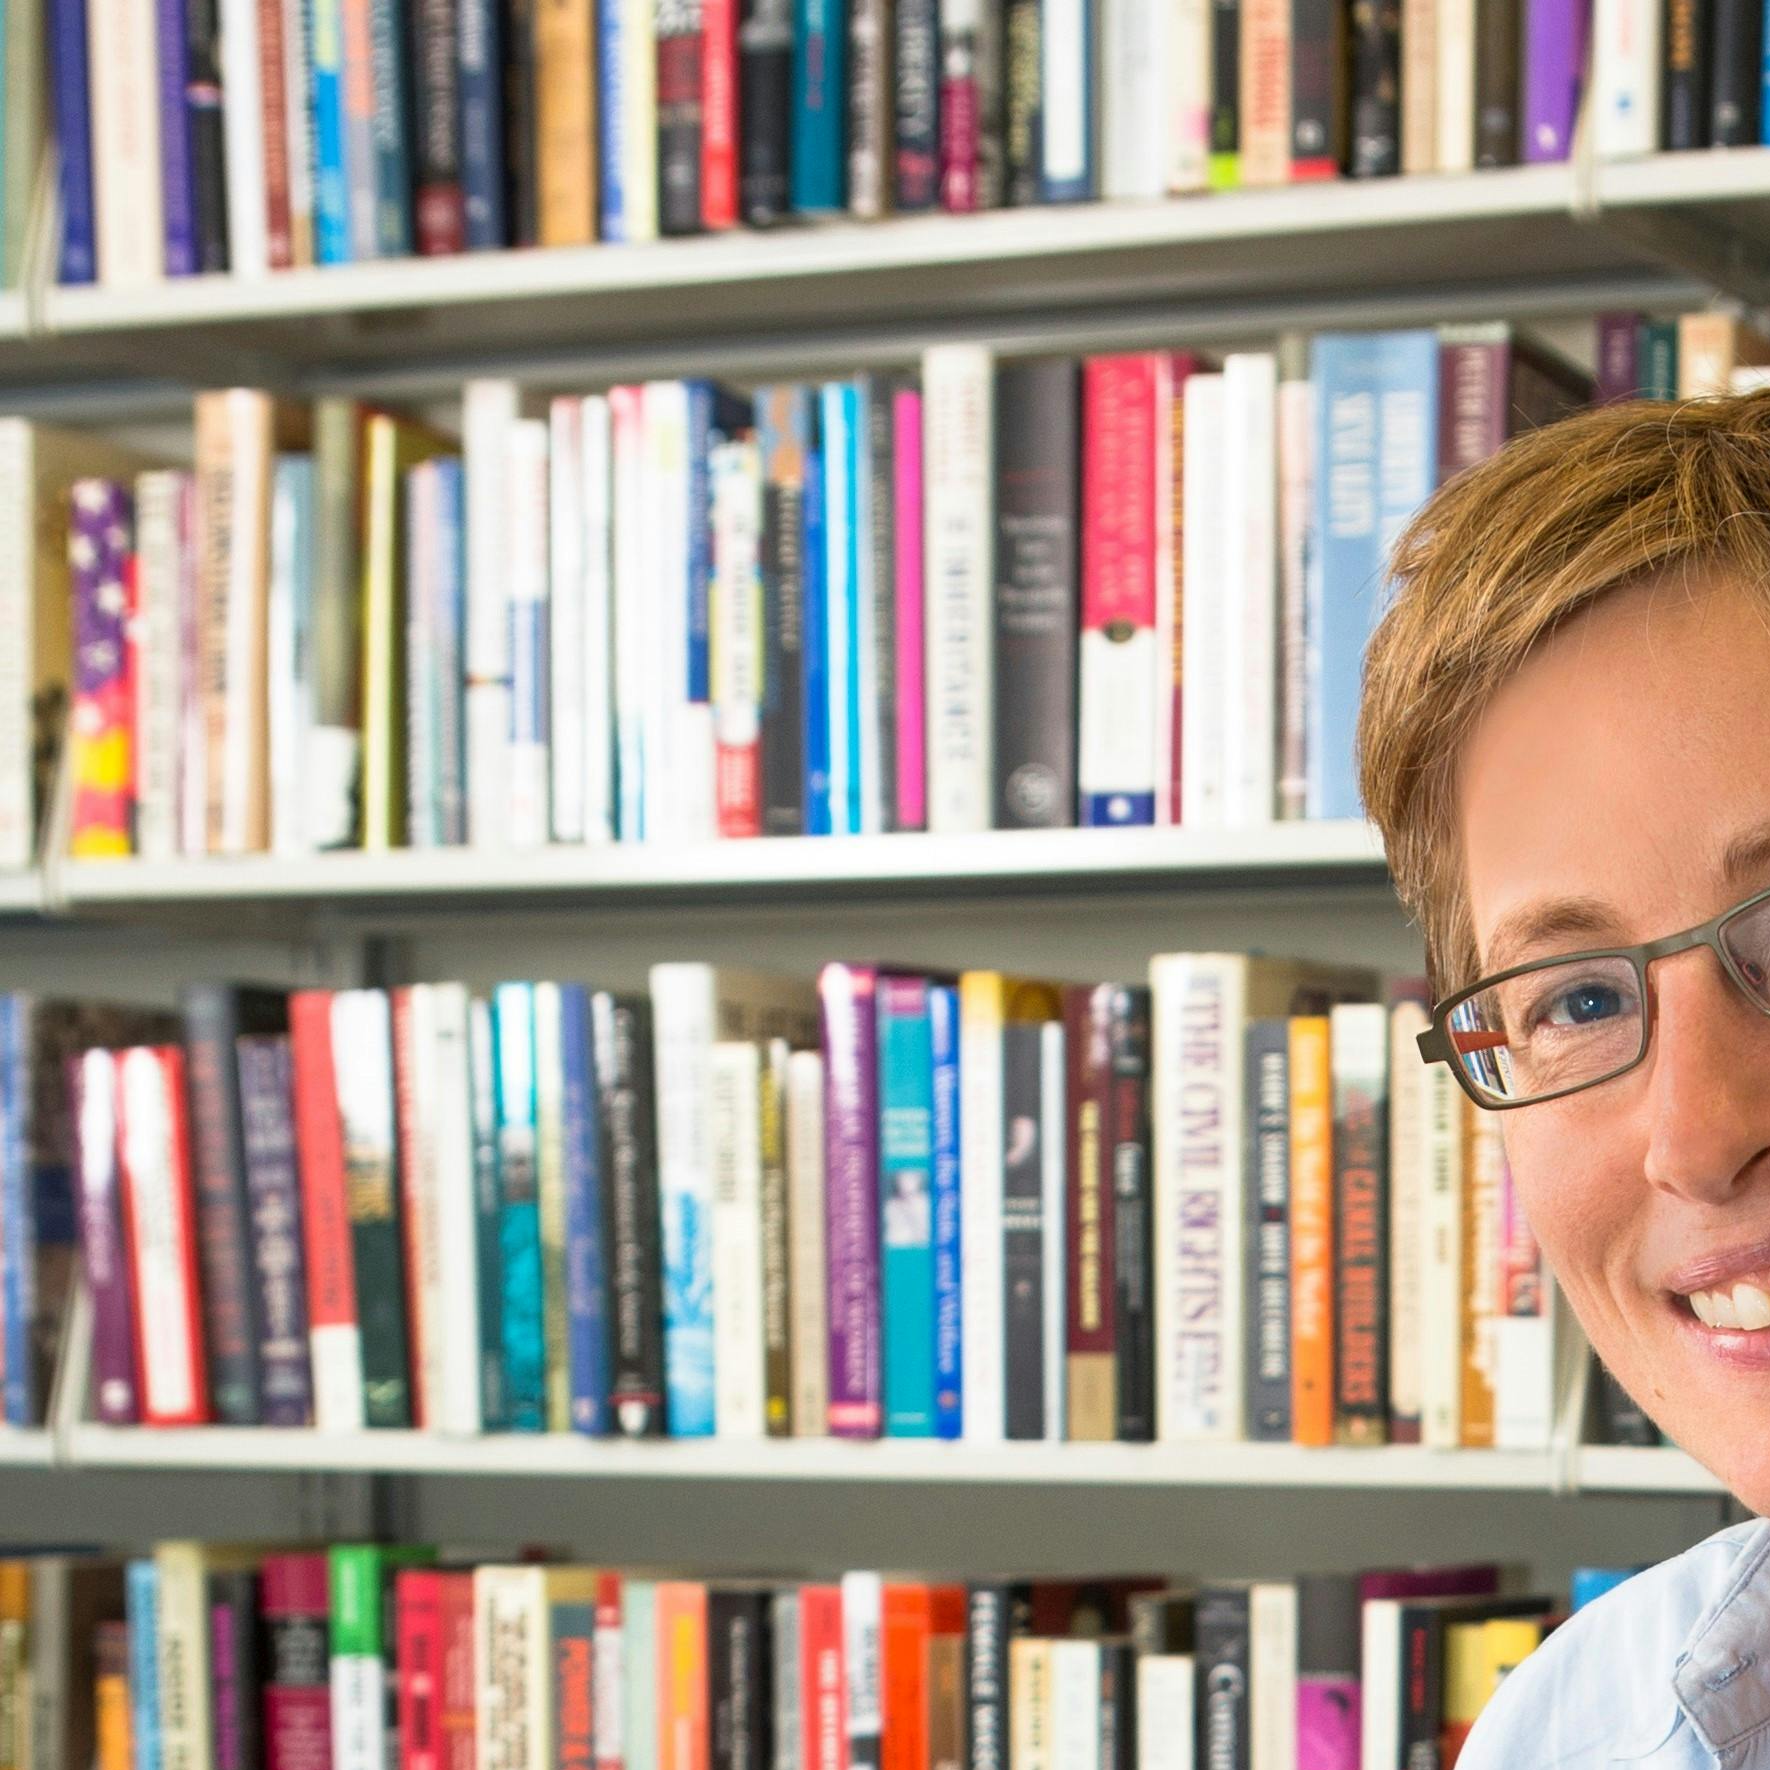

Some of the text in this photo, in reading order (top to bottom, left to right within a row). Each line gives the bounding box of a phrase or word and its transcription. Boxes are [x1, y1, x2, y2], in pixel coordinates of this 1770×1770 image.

[1179, 1002, 1221, 1070] THE
[1179, 1085, 1220, 1183] CIVIL
[1176, 1190, 1220, 1324] RIGHTS
[1343, 1167, 1375, 1404] CANAL BUILDERS
[971, 1590, 999, 1700] FEMALE
